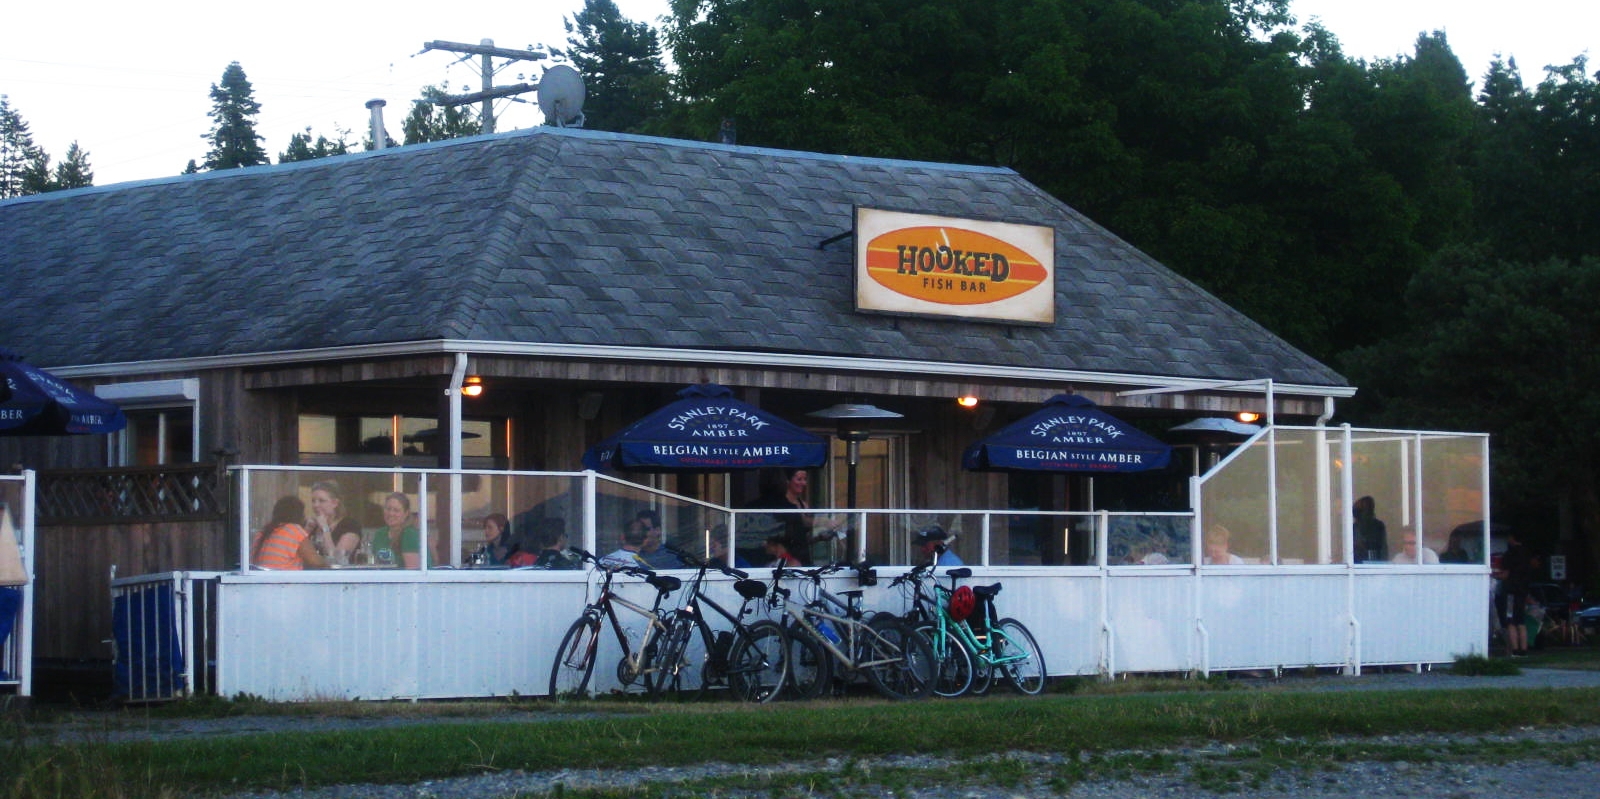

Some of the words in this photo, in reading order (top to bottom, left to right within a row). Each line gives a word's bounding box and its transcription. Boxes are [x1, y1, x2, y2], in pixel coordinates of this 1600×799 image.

[896, 244, 1010, 282] HOOKED
[923, 277, 953, 291] FISH
[960, 280, 987, 293] BAR
[667, 406, 726, 431] STANLEY
[728, 408, 770, 431] PARK
[691, 429, 749, 438] AMBER
[1031, 415, 1086, 438] STANLEY
[1088, 418, 1125, 440] PARK
[1052, 436, 1105, 444] AMBER
[653, 445, 709, 456] BELGIAN
[712, 447, 739, 456] STYLE
[743, 446, 790, 457] AMBER
[1016, 450, 1068, 460] BELGIAN
[1071, 453, 1095, 461] STYLE
[1099, 453, 1142, 464] AMBER
